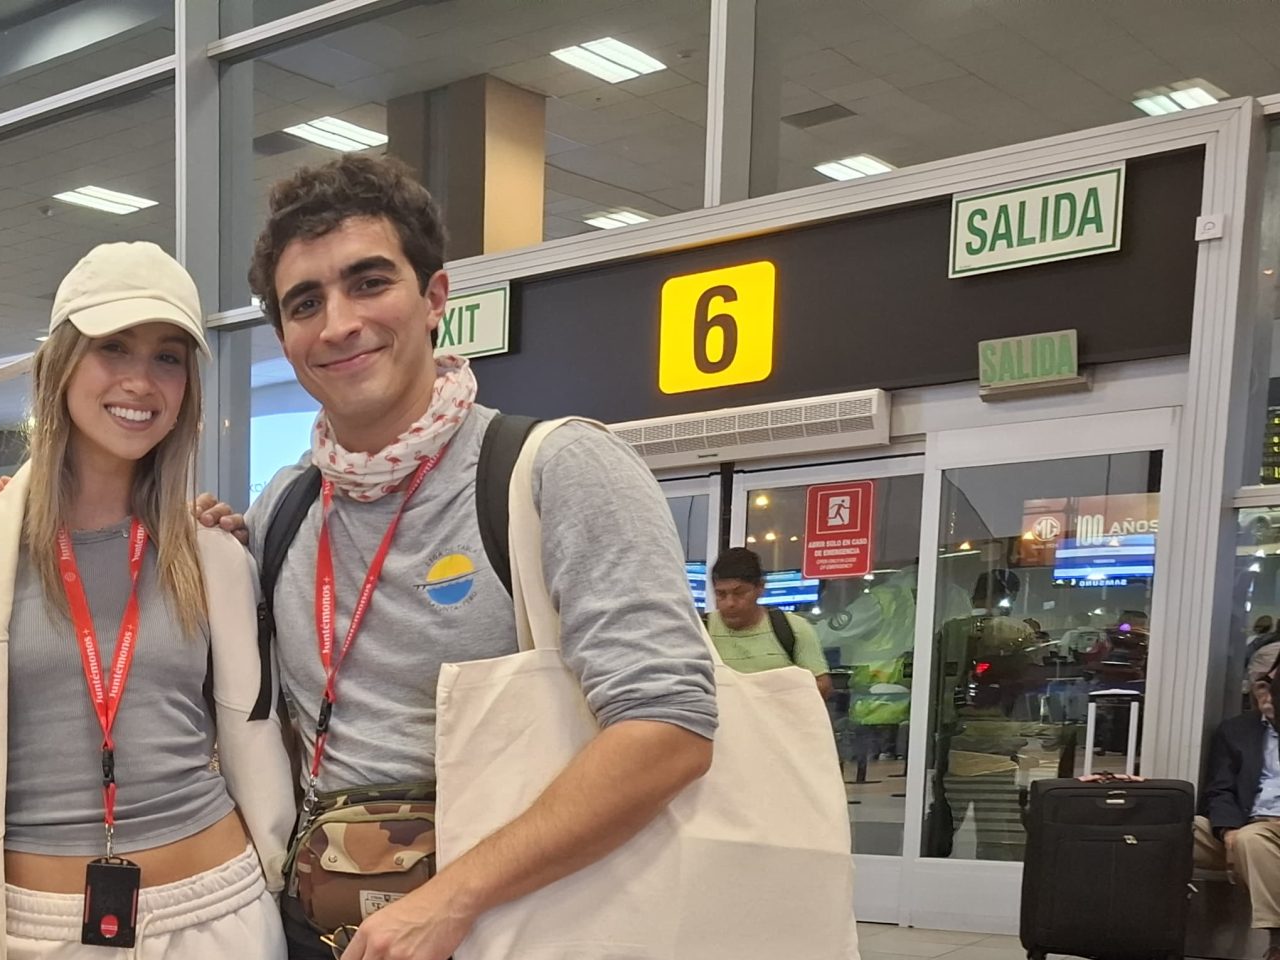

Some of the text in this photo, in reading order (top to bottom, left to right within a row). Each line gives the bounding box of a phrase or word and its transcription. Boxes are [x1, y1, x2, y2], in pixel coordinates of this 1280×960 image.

[965, 186, 1104, 256] SALIDA
[439, 303, 481, 349] XIT
[693, 284, 738, 374] 6
[980, 334, 1076, 384] SALIDA
[1034, 518, 1060, 540] MG
[1076, 514, 1160, 546] 100 AÑOS
[83, 636, 105, 704] Juntémonos
[109, 631, 133, 698] Juntémonos
